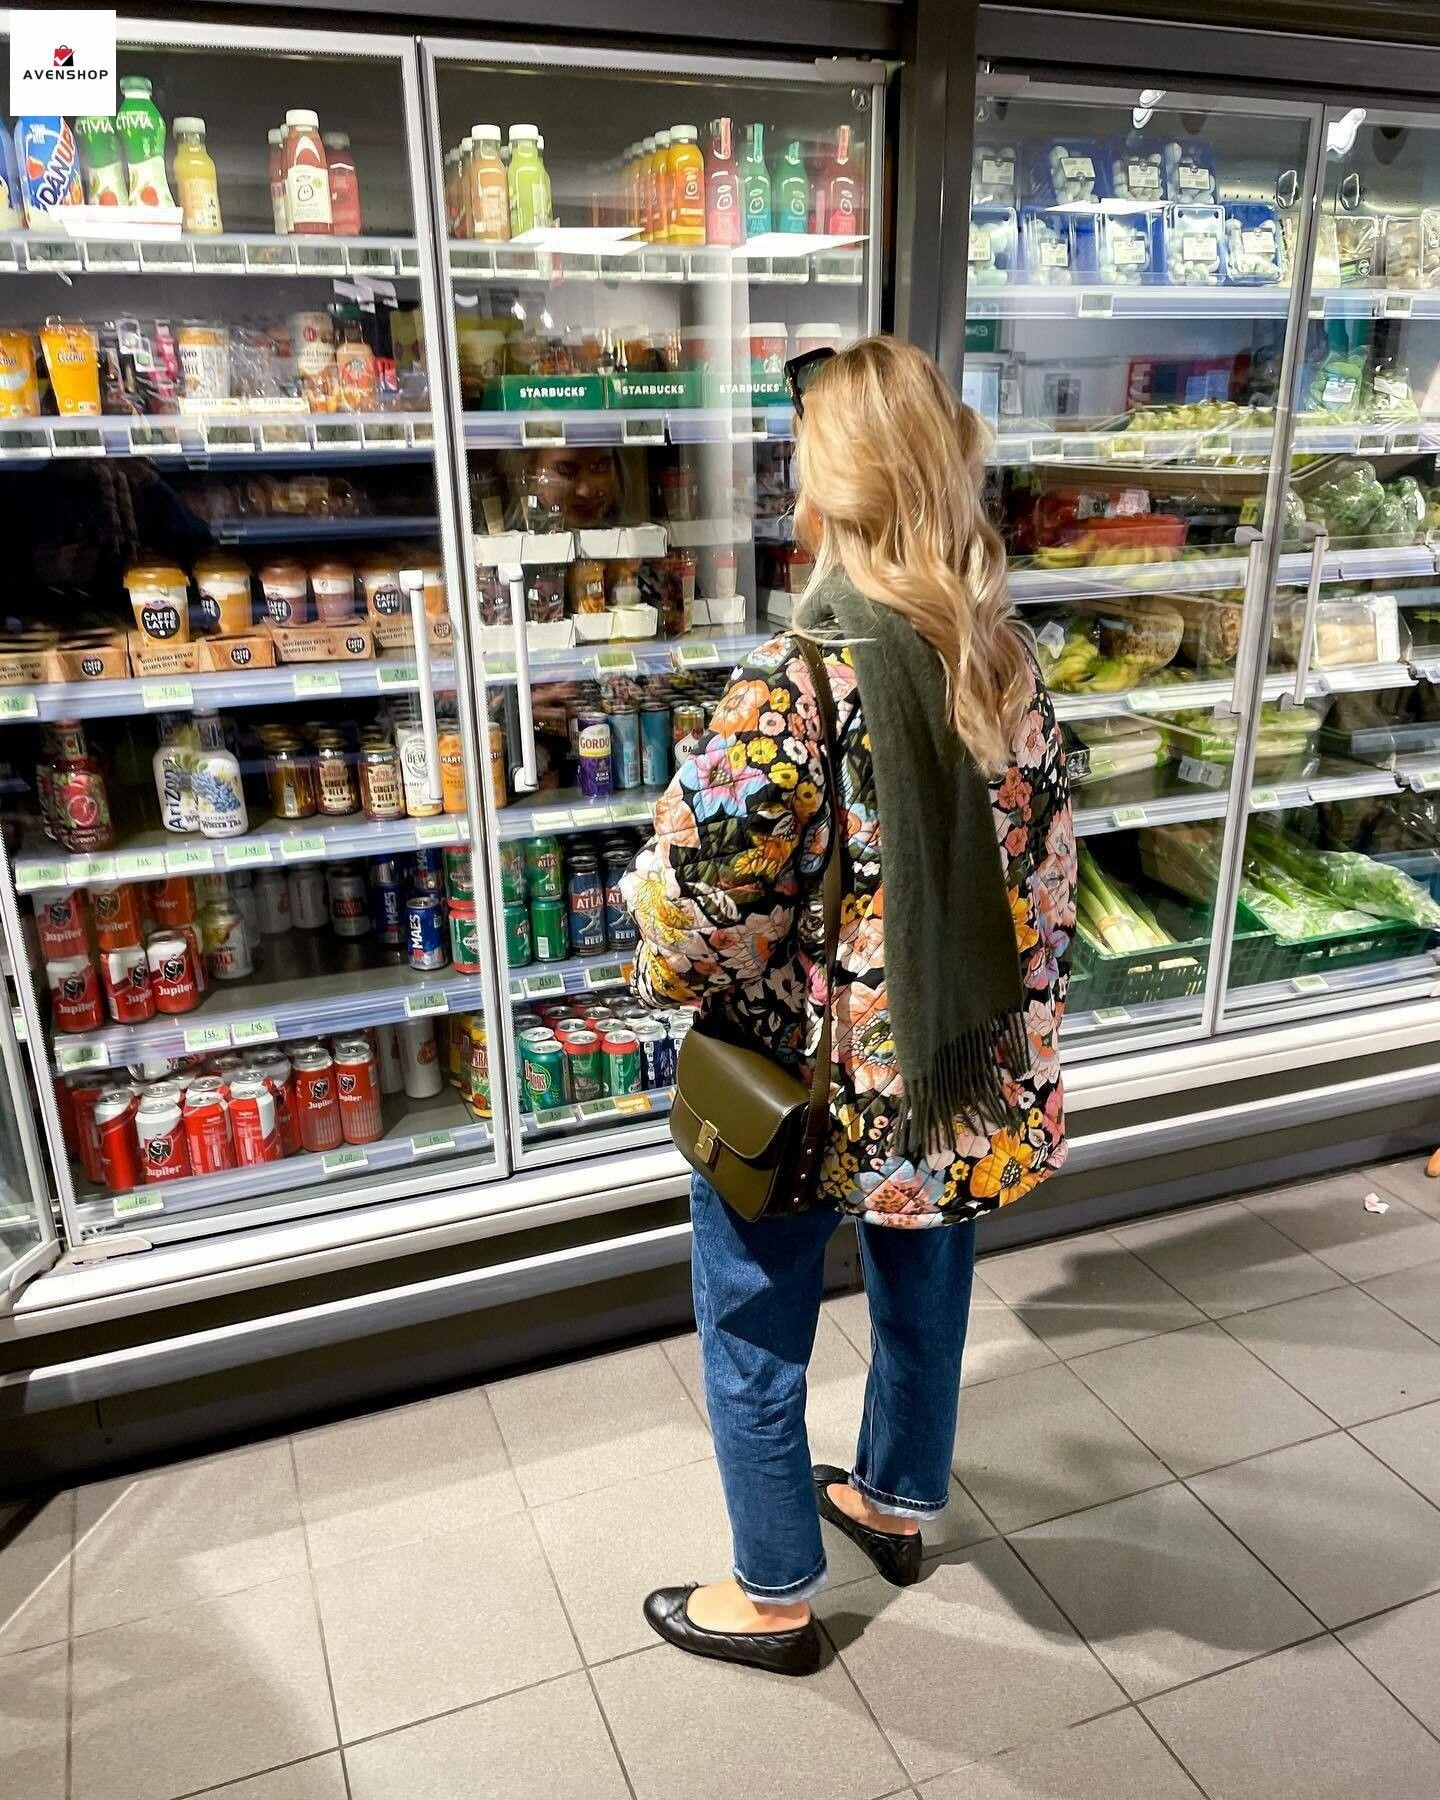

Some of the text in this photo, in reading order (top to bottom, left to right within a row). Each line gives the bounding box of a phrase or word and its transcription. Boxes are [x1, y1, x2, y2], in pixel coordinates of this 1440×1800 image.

[519, 386, 586, 398] STARBUCKS
[621, 384, 686, 395] STARBUCKS
[719, 383, 781, 393] STARBUCKS
[146, 620, 177, 630] LATTE
[580, 737, 610, 749] GORDO
[682, 745, 694, 753] BA
[44, 927, 84, 943] Jupiler
[410, 914, 424, 949] MAES
[158, 983, 195, 997] Jupiler
[58, 1001, 96, 1015] Jupiler
[145, 1164, 182, 1178] Jupiler
